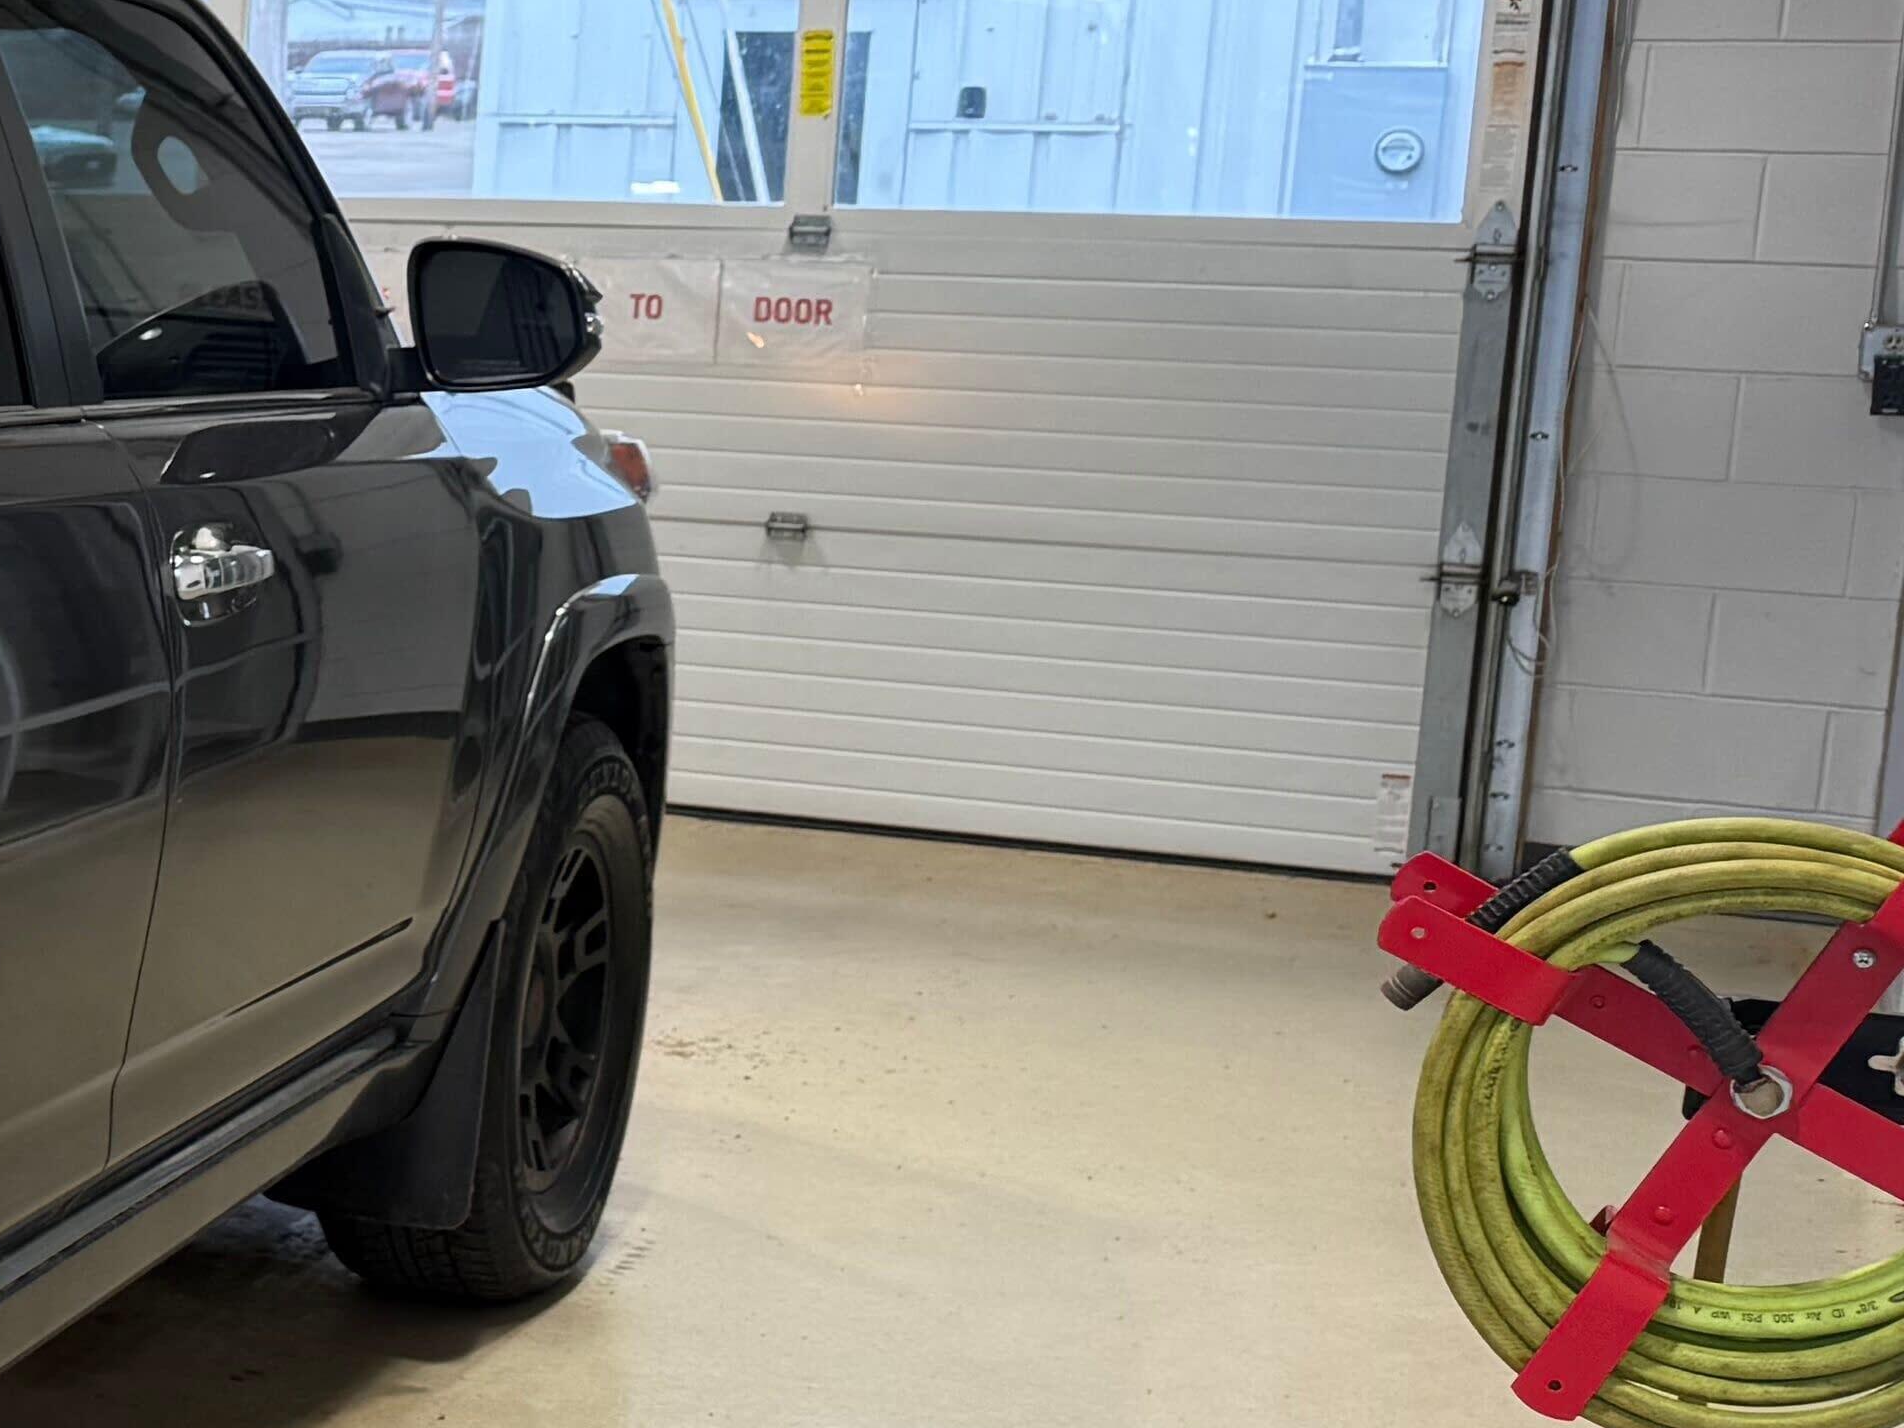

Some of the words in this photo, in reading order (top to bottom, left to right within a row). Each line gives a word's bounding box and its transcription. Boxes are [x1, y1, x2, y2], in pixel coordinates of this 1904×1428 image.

[630, 294, 663, 320] TO
[753, 296, 834, 326] DOOR
[1772, 1313, 1795, 1324] 300
[1805, 1310, 1822, 1321] Air
[1831, 1308, 1845, 1319] ID
